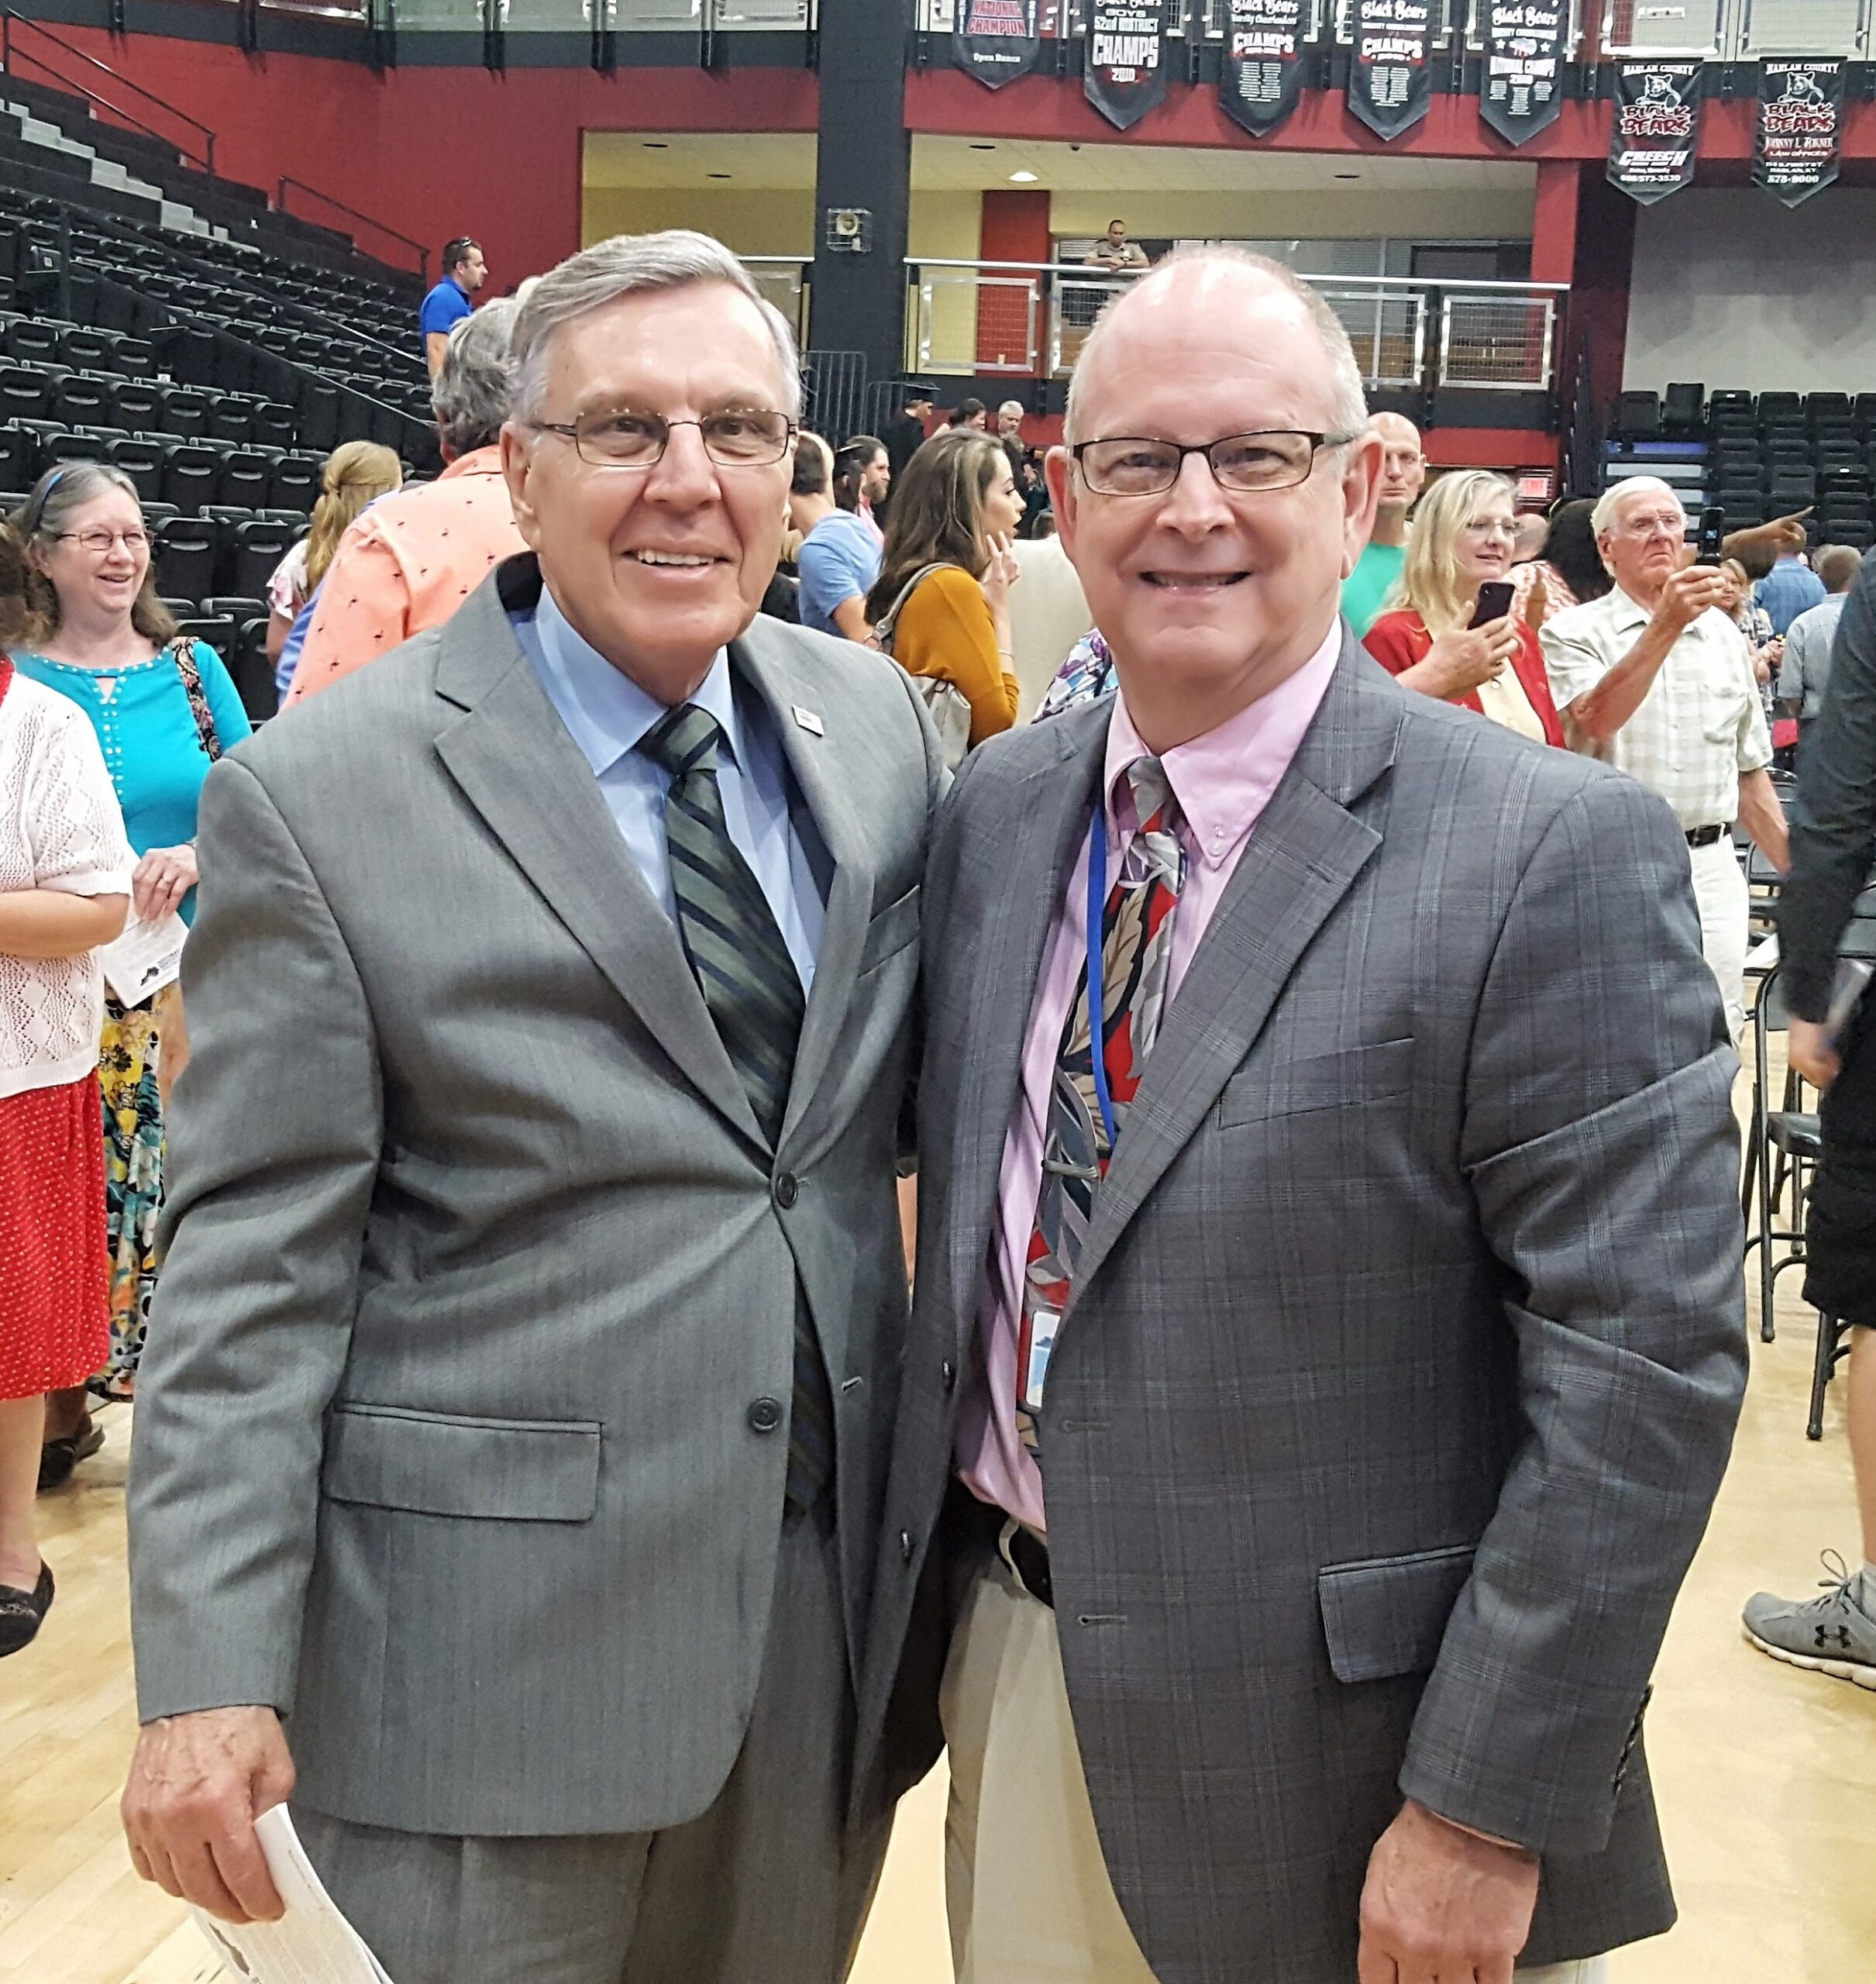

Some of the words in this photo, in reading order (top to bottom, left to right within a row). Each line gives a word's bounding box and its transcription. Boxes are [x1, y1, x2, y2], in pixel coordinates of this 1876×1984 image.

[1105, 9, 1146, 18] BOYS
[1361, 0, 1392, 19] Black
[1395, 0, 1427, 20] Bears
[1492, 5, 1523, 26] Black
[1525, 6, 1558, 26] Bears
[966, 16, 1027, 36] CHAMPION
[1092, 33, 1160, 68] CHAMPS
[1234, 32, 1295, 55] CHAMPS
[1362, 37, 1423, 59] CHAMPS
[1623, 64, 1658, 76] HARLAN
[1660, 64, 1695, 75] COUNTY
[1766, 63, 1802, 75] HARLAN
[1803, 63, 1839, 74] COUNTY
[1620, 117, 1691, 136] BEARS
[1762, 115, 1836, 133] BEARS
[1619, 150, 1689, 167] CREECH
